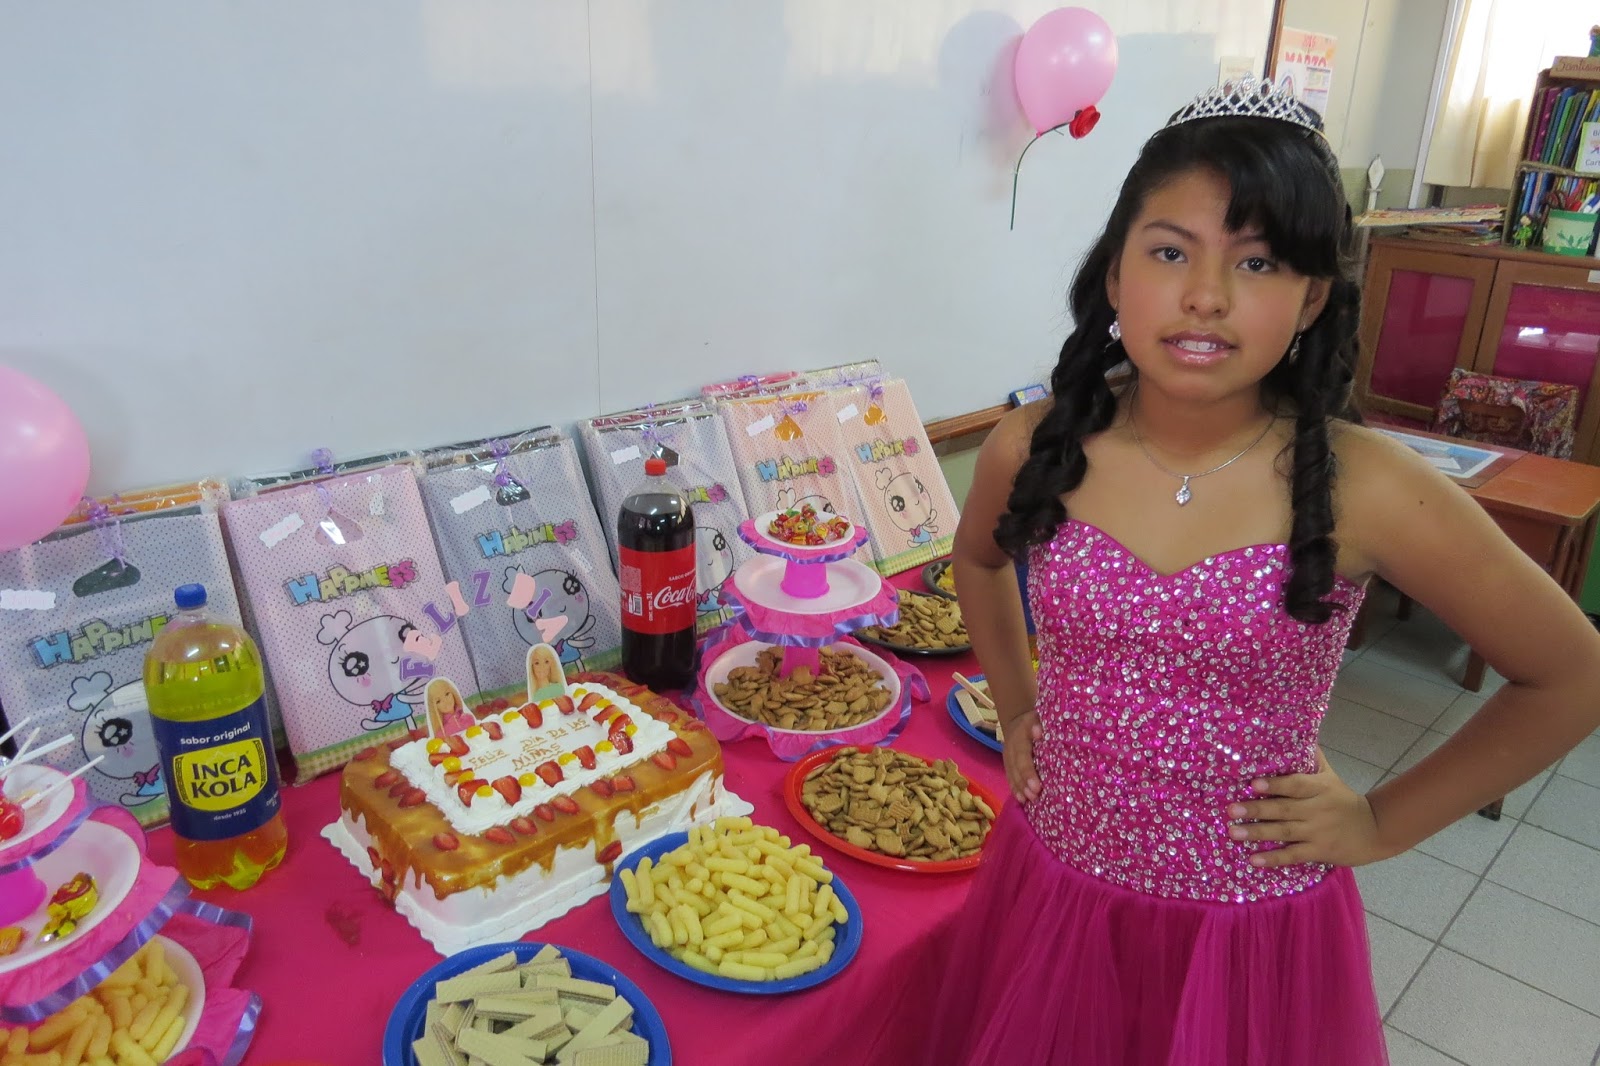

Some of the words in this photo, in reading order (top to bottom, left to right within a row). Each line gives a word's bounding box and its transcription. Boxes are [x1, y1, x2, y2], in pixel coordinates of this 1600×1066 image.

[180, 736, 211, 745] sabor
[213, 721, 251, 743] original
[192, 754, 252, 780] INCA
[190, 771, 258, 798] KOLA
[213, 813, 232, 821] desde
